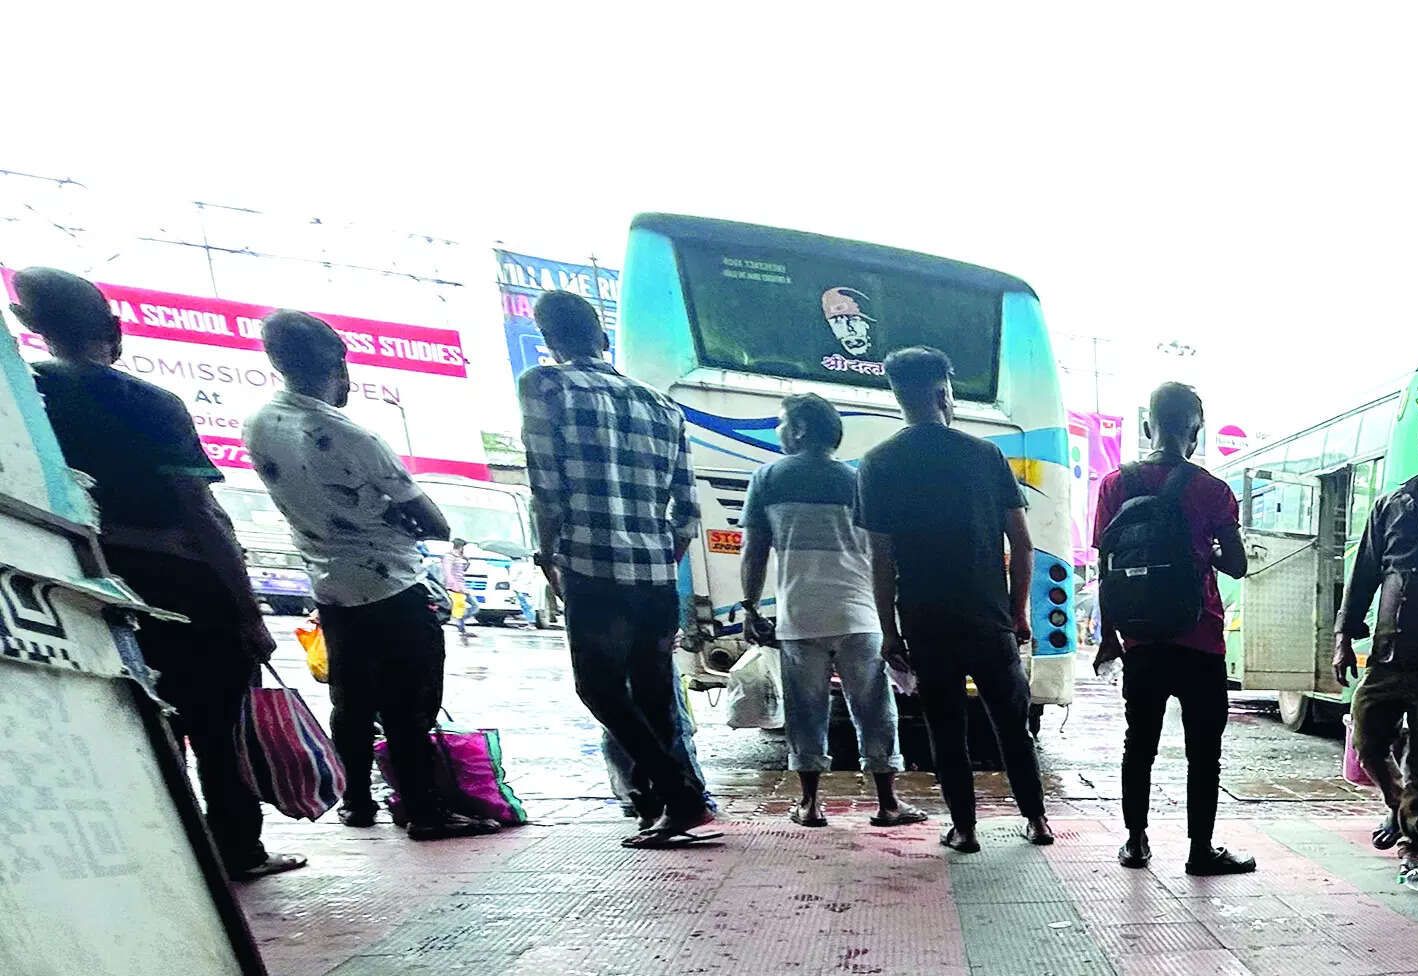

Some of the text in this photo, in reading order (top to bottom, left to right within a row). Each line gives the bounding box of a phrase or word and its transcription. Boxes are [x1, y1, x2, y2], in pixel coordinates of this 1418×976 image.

[140, 303, 235, 336] SCHOOL
[378, 335, 464, 366] STUDIES
[195, 389, 223, 405] At
[349, 381, 400, 403] PEN
